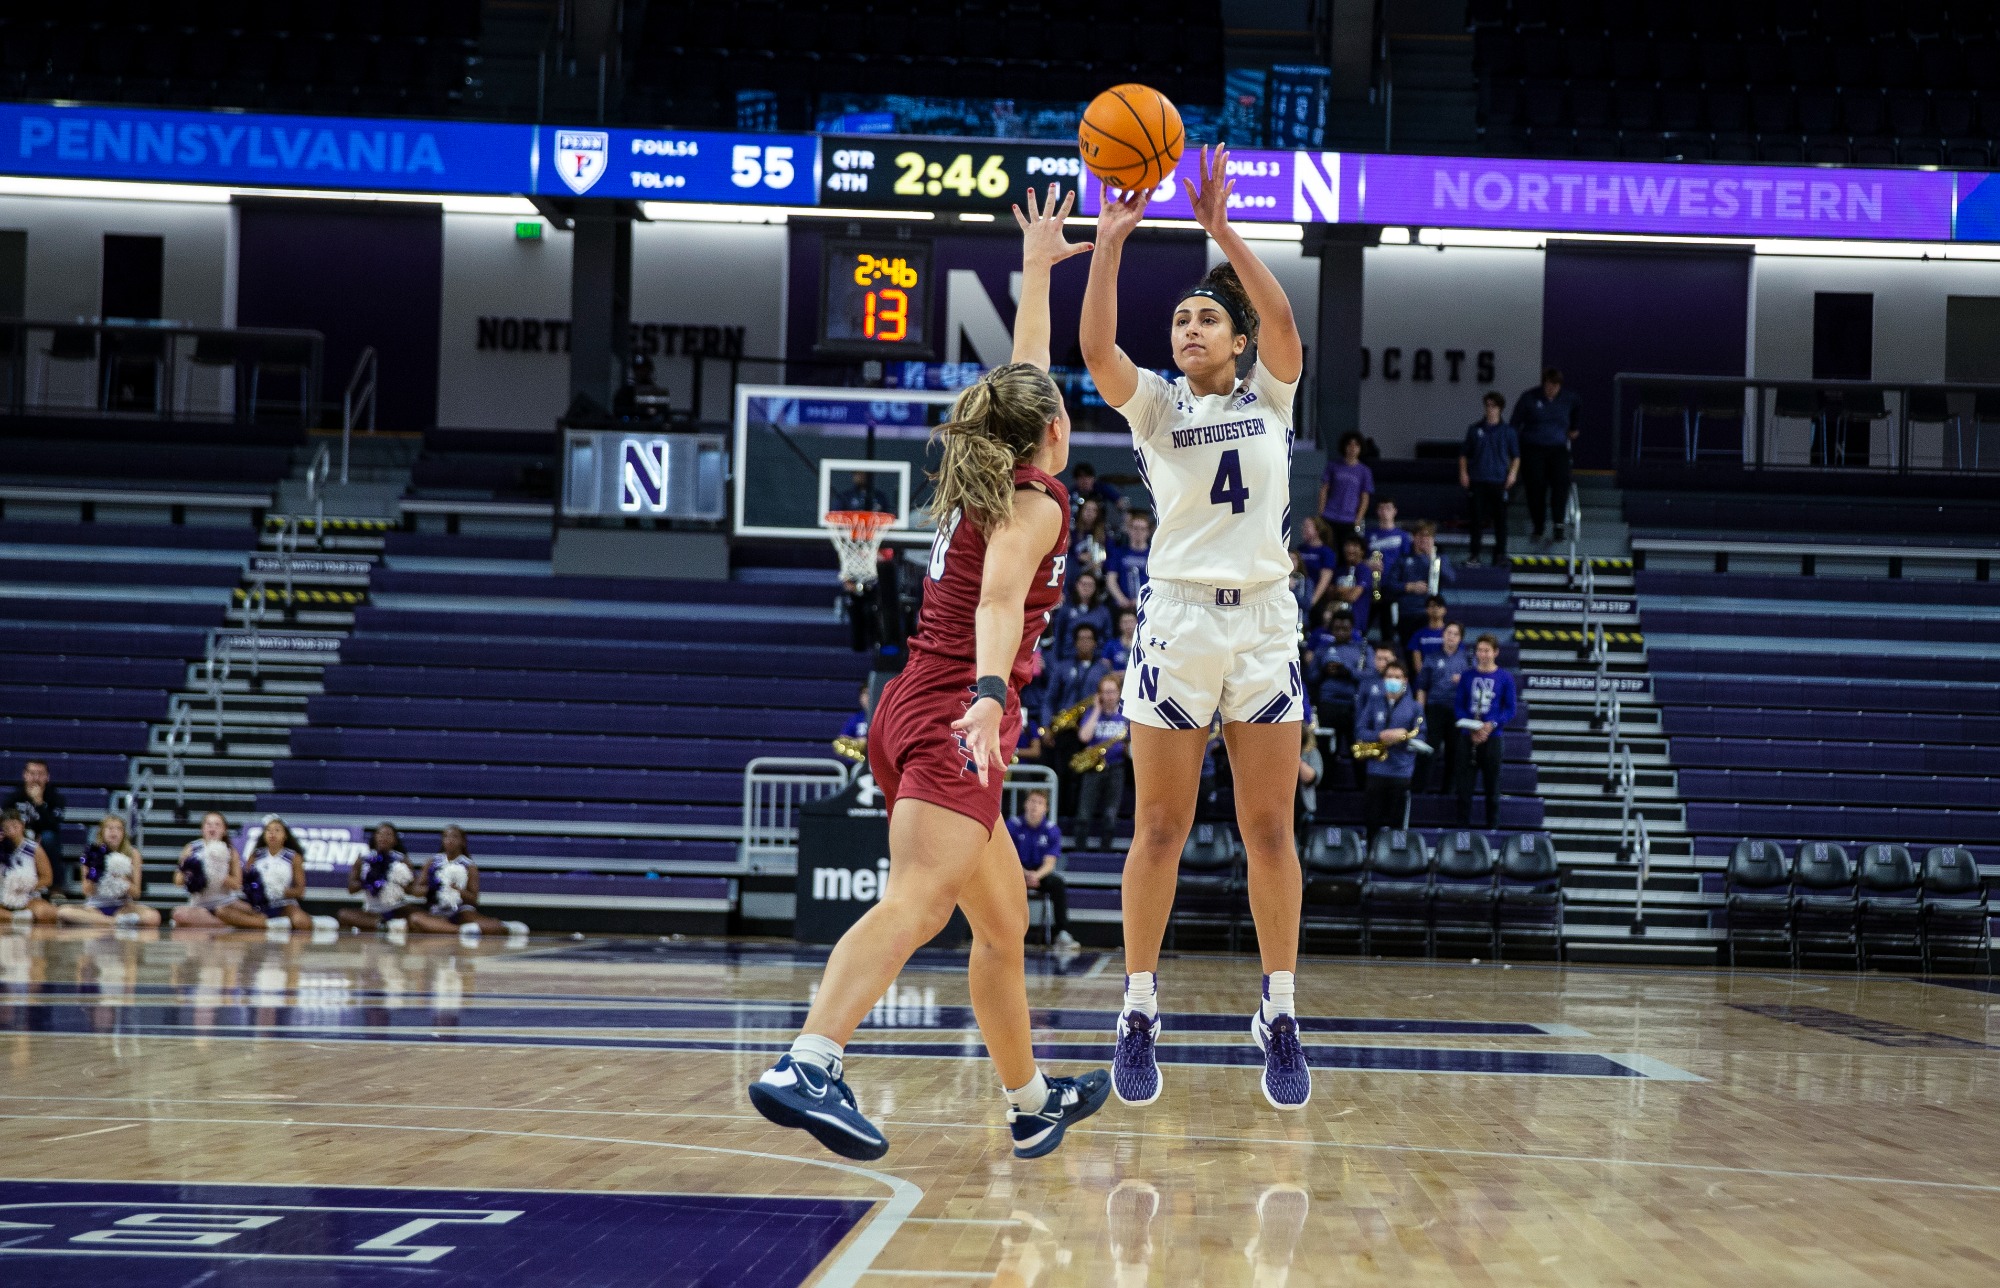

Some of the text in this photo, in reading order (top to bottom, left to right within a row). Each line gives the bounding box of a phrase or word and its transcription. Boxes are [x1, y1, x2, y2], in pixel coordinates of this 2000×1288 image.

[20, 117, 445, 174] PENNSYLVANIA
[832, 150, 875, 169] QTR
[731, 145, 794, 189] 55
[827, 173, 868, 192] 4TH
[893, 152, 1009, 198] 2:46
[1027, 157, 1080, 176] POSS
[1226, 161, 1267, 176] OULS
[1294, 151, 1340, 223] N
[1433, 169, 1882, 222] NORTHWESTERN
[855, 253, 917, 288] 2:46
[863, 289, 907, 341] 13
[1172, 418, 1266, 448] NORTHWESTERN
[619, 440, 669, 512] N
[1210, 449, 1249, 515] 4
[1223, 590, 1233, 604] N
[1518, 599, 1552, 610] PLEASE
[1552, 600, 1583, 611] WATCH
[1609, 602, 1631, 613] STEP
[1138, 664, 1160, 702] N
[1528, 676, 1562, 688] PLEASE
[1563, 677, 1595, 690] WATCH
[1620, 680, 1644, 691] STEP
[812, 858, 890, 901] mei
